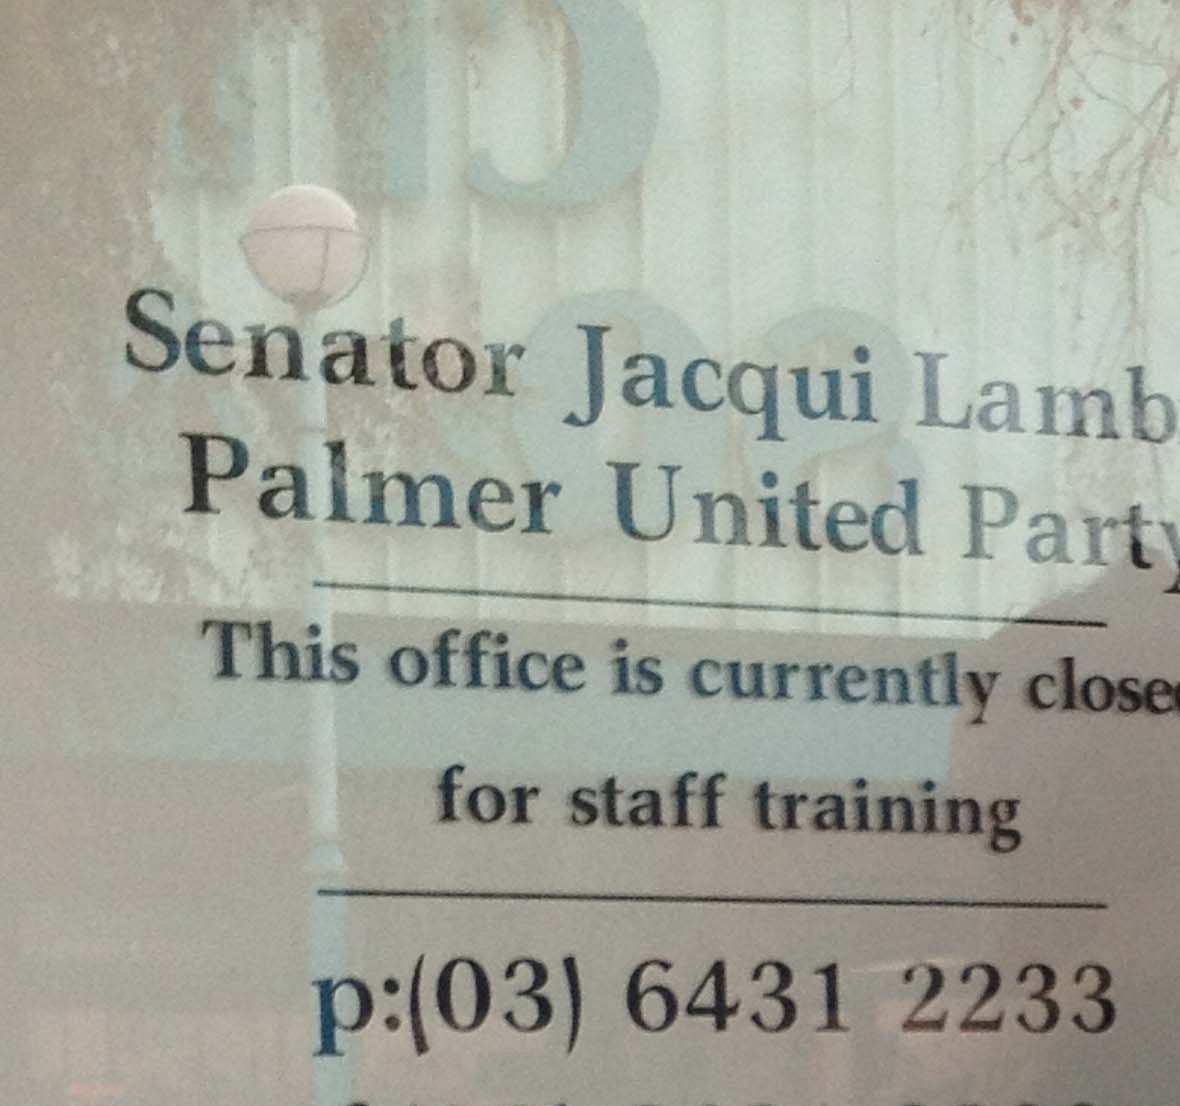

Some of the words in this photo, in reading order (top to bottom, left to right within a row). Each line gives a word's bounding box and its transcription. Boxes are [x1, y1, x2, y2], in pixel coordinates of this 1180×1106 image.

[125, 288, 526, 397] Senator
[563, 324, 878, 442] Jacqui
[179, 431, 563, 536] Palmer
[606, 461, 924, 556] United
[198, 618, 360, 685] This
[385, 627, 585, 694] office
[610, 637, 664, 697] is
[687, 651, 1000, 725] currently
[434, 763, 541, 825] for
[567, 771, 727, 829] staff
[751, 778, 1022, 854] training
[312, 954, 582, 1057] p:(03)
[625, 958, 847, 1033] 6431
[902, 963, 1116, 1034] 2233
